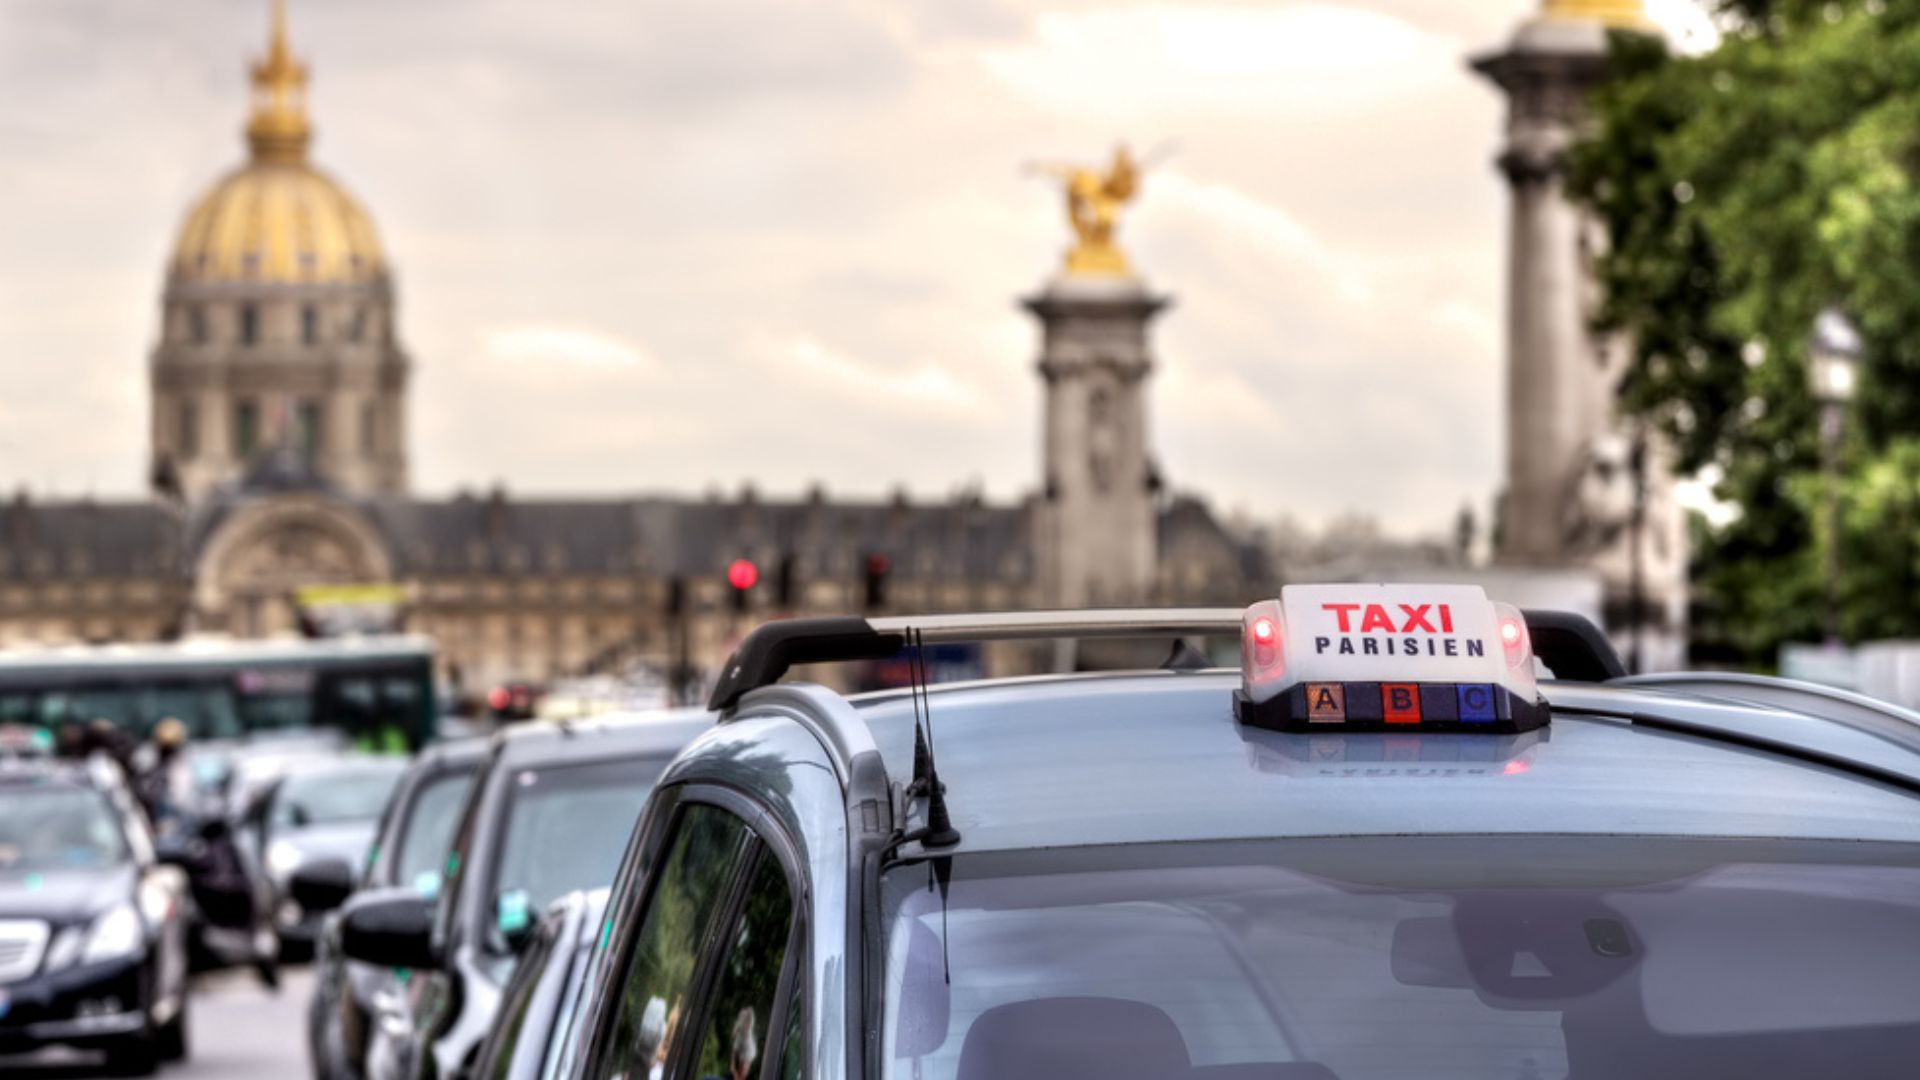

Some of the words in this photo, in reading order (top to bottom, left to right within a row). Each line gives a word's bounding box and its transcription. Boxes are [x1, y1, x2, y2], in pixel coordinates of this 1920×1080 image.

[1321, 604, 1454, 633] TAXI
[1315, 637, 1484, 657] PARISIEN
[1315, 688, 1338, 710] A
[1391, 687, 1413, 710] B
[1464, 687, 1487, 710] C
